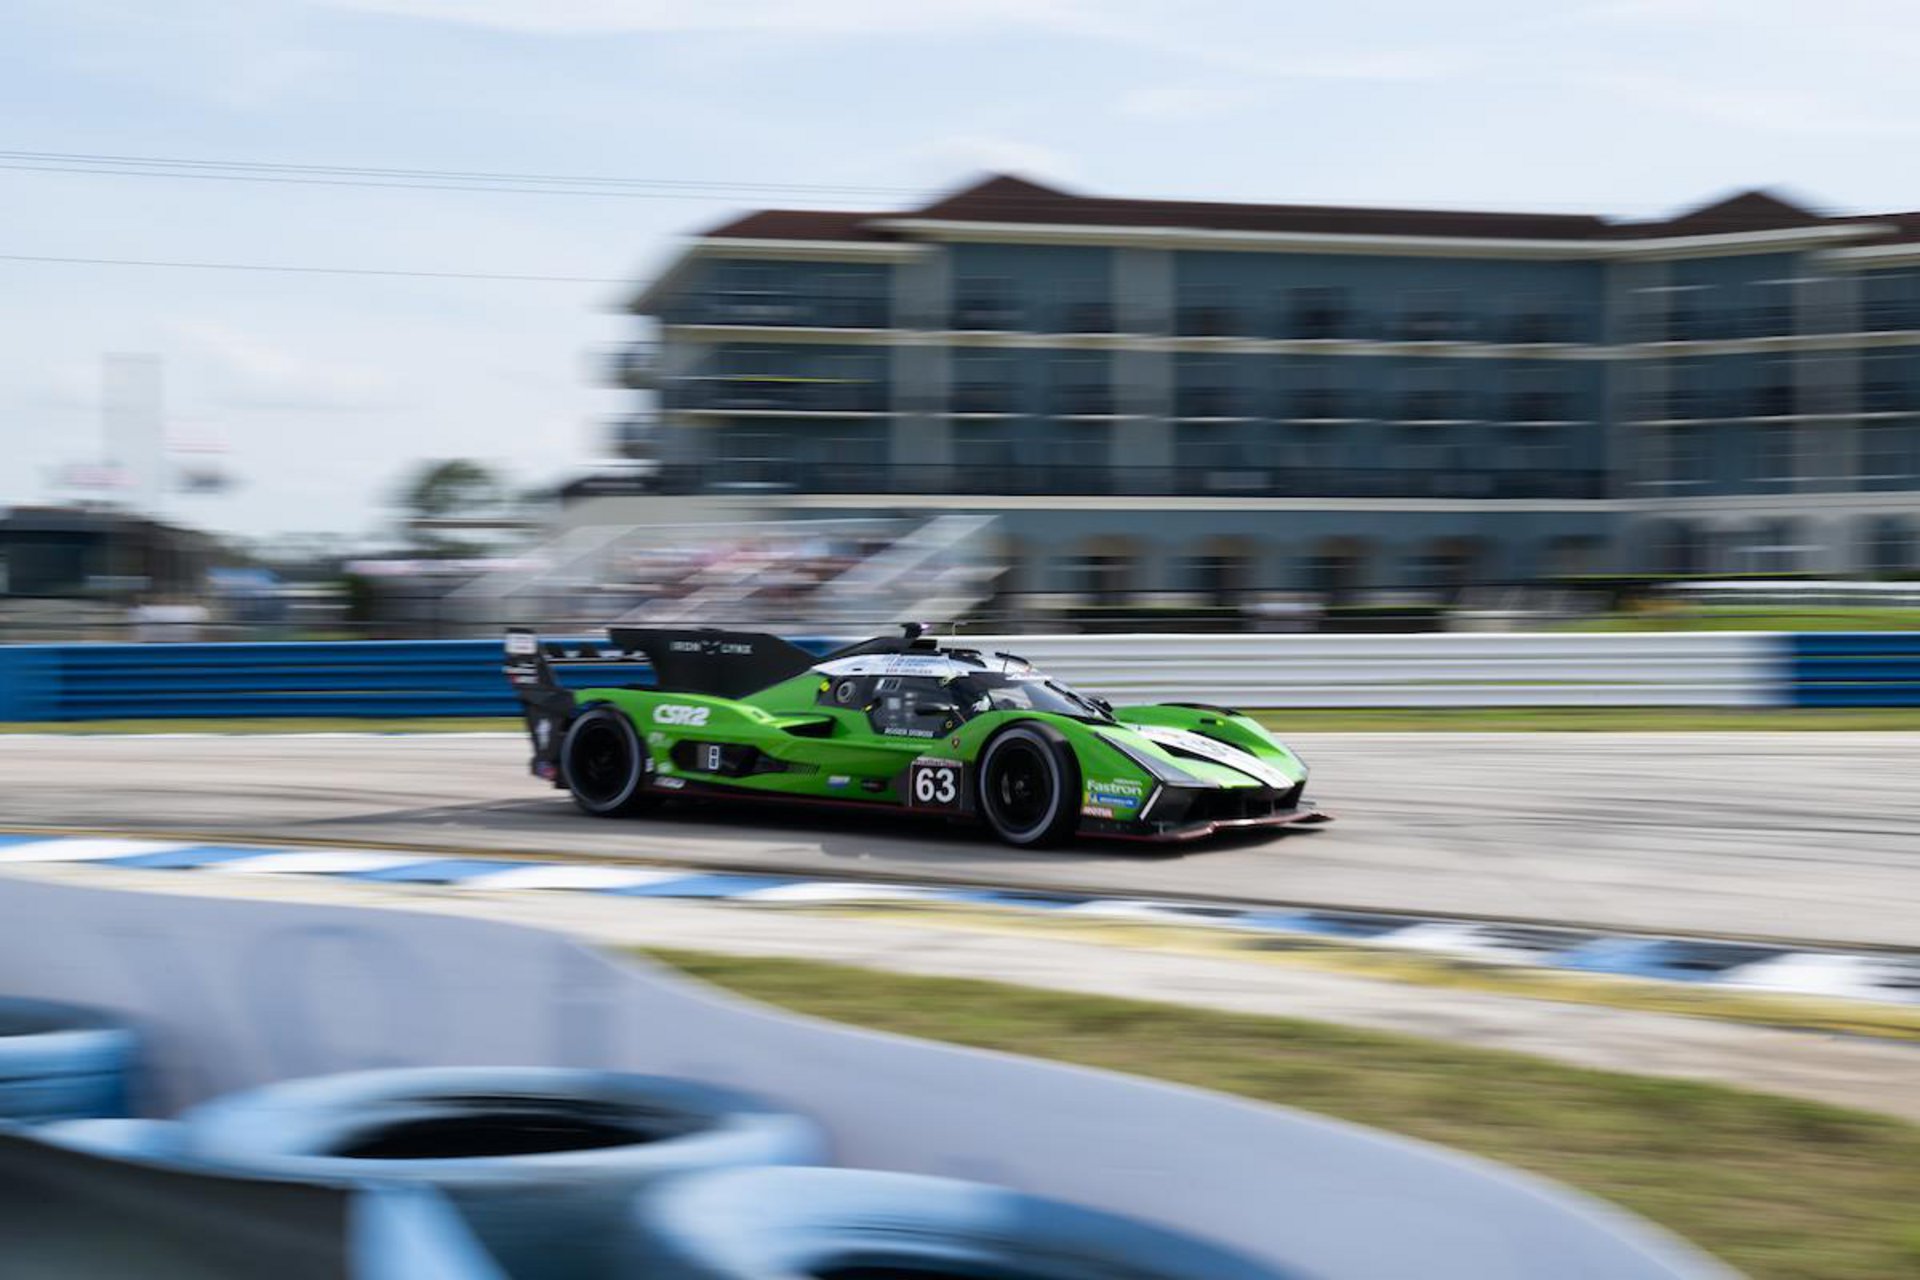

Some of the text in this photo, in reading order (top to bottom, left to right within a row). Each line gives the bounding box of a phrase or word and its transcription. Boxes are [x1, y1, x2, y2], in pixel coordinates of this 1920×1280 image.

[652, 704, 711, 726] CSR2
[915, 767, 956, 803] 63
[1087, 779, 1142, 797] Fastron
